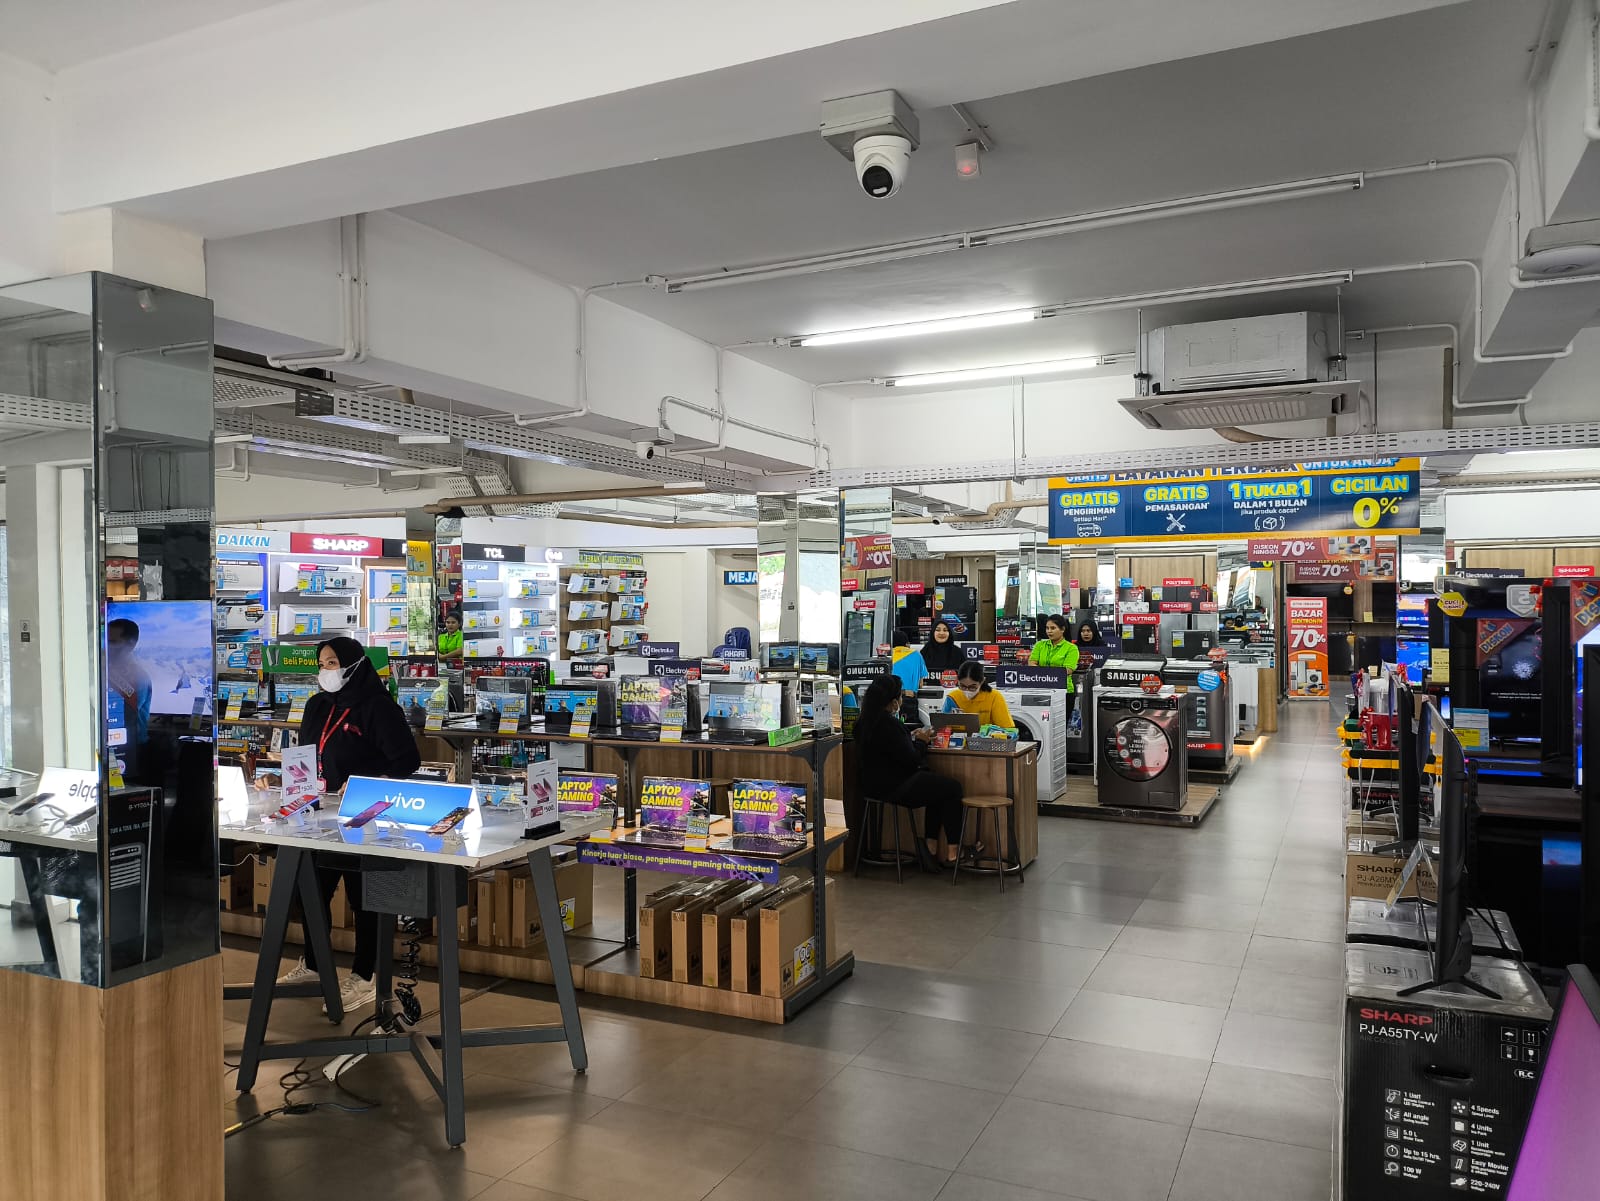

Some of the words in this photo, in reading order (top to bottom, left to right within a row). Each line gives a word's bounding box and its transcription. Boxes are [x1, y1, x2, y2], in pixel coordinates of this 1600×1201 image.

[1231, 483, 1240, 498] 1
[1244, 484, 1298, 498] TUKAR
[1301, 479, 1310, 495] 1
[1333, 477, 1407, 493] CICILAN
[1061, 492, 1119, 507] GRATIS
[1144, 485, 1209, 502] GRATIS
[1234, 501, 1267, 509] DALAM
[1275, 499, 1307, 507] BULAN
[1063, 507, 1116, 516] PENGIRIMAN
[218, 534, 270, 547] DAIKIN
[312, 537, 369, 551] SHARP
[484, 547, 505, 559] TCL
[1281, 541, 1315, 557] 70%
[1322, 564, 1350, 577] 70%
[728, 571, 758, 585] MEJA
[1290, 610, 1324, 618] BAZAR
[1576, 598, 1600, 625] DIS
[1290, 629, 1326, 648] 70%
[1481, 623, 1514, 653] DISKON
[292, 648, 315, 656] Jangan
[724, 649, 747, 659] AKARI
[283, 656, 298, 665] Beli
[574, 664, 594, 672] SAMS
[1019, 674, 1058, 682] Electrolux
[557, 781, 593, 791] LAPTOP
[642, 784, 682, 796] LAPTOP
[557, 792, 594, 802] GAMING
[641, 795, 684, 807] GAMING
[734, 789, 777, 801] LAPTOP
[385, 793, 426, 810] vivo
[733, 800, 779, 813] GAMING
[582, 849, 607, 859] Kinerja
[607, 851, 622, 859] luar
[623, 852, 645, 862] biasa,
[645, 855, 692, 866] pengalaman
[692, 859, 722, 870] gaming
[723, 861, 737, 870] tak
[737, 862, 774, 874] terbatas!
[1356, 864, 1402, 874] SHARP
[1360, 1008, 1434, 1026] SHARP
[1359, 1023, 1438, 1043] PJ-A55TY-W
[1408, 1092, 1421, 1100] Unit
[1476, 1105, 1500, 1115] Speeds
[1412, 1113, 1430, 1122] angle
[1476, 1124, 1493, 1133] Units
[1476, 1140, 1490, 1148] Unit
[1403, 1147, 1412, 1156] Up
[1471, 1158, 1487, 1168] Easy
[1415, 1167, 1422, 1175] W
[1470, 1179, 1501, 1190] 220-240V
